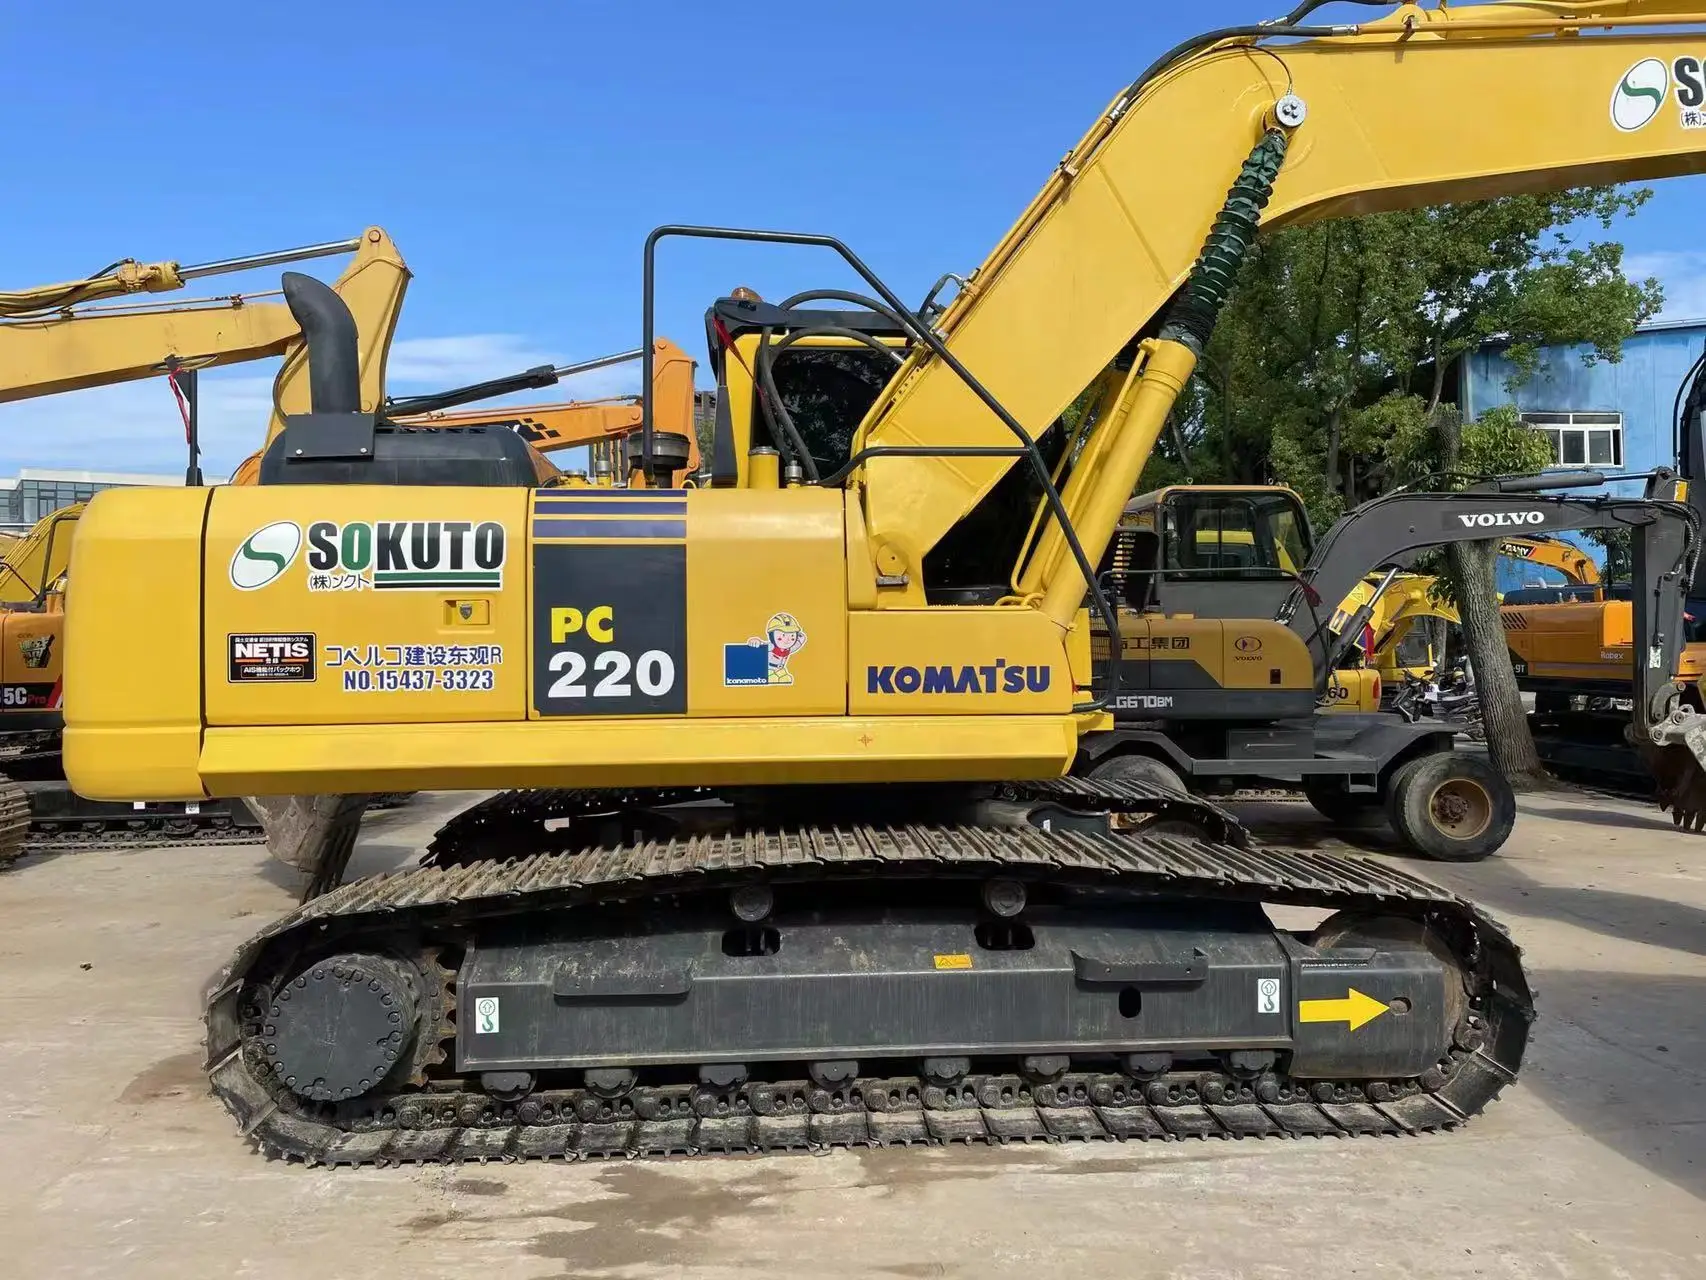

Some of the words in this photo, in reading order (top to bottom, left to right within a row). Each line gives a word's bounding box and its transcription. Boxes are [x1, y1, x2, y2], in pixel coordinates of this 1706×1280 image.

[1674, 56, 1706, 107] S
[1458, 511, 1545, 528] VOLVO
[309, 522, 504, 570] SOKUTO
[551, 606, 614, 643] PC
[235, 643, 309, 657] NETIS
[344, 670, 494, 690] NO.15437-3323
[548, 650, 675, 698] 220
[867, 658, 1050, 693] KOMATSU
[0, 687, 27, 705] 5C
